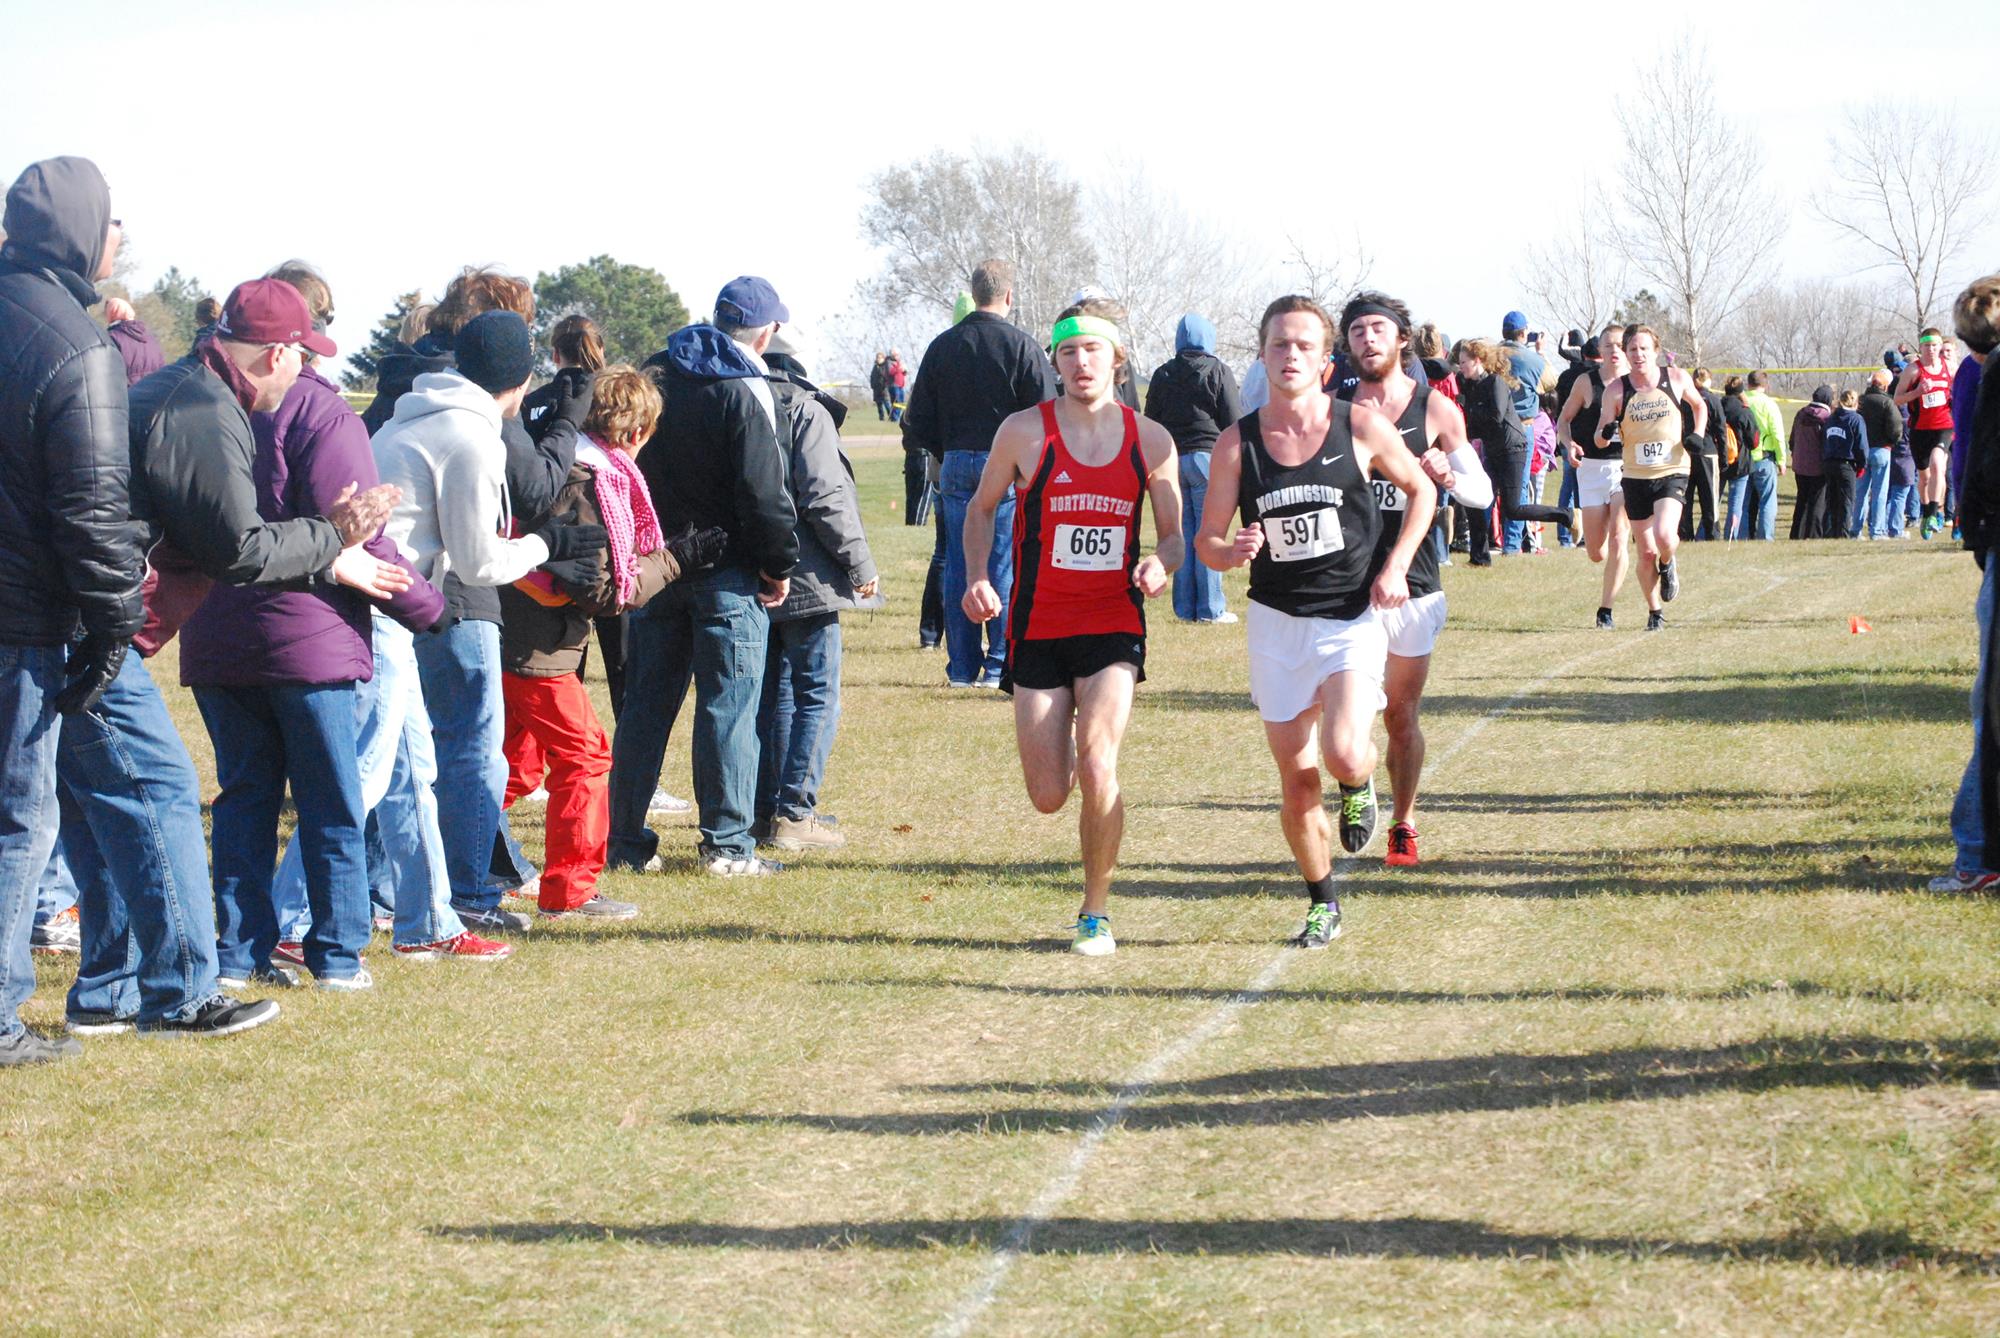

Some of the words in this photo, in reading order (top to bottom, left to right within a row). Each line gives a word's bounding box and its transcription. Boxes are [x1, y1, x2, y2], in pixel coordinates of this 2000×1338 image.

[1643, 443, 1663, 457] 642
[1050, 493, 1134, 516] NORTHWESTERN
[1070, 528, 1112, 555] 665
[1281, 513, 1320, 545] 597
